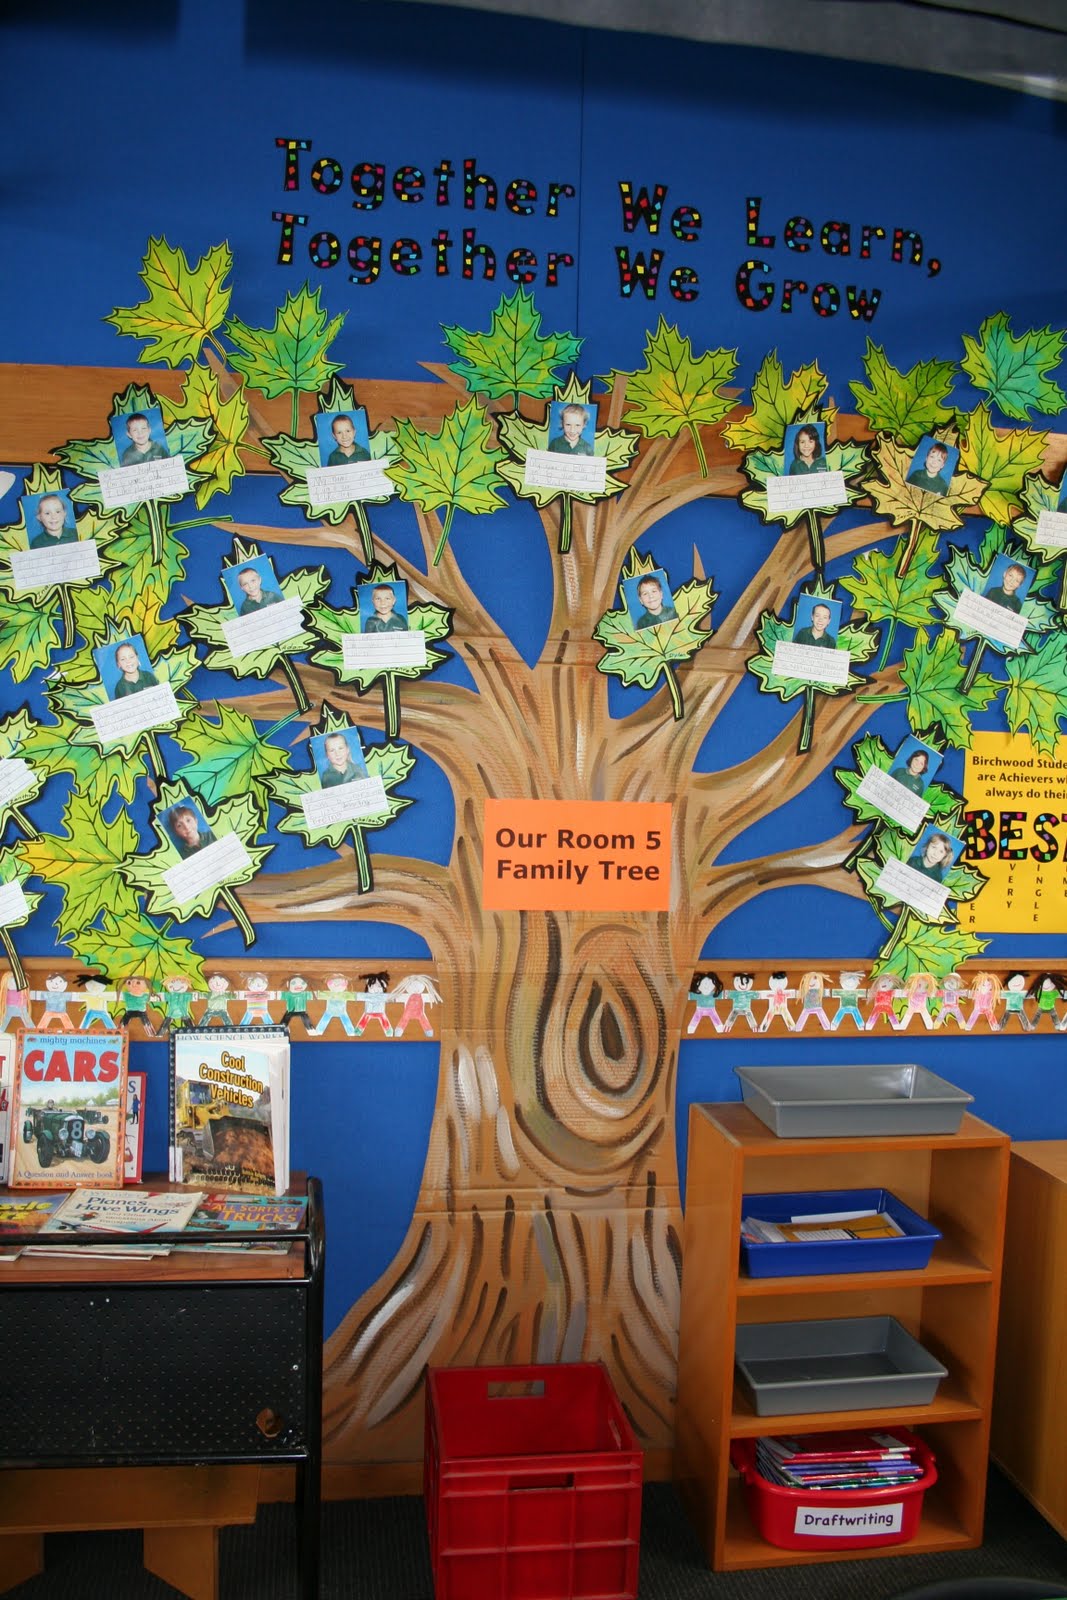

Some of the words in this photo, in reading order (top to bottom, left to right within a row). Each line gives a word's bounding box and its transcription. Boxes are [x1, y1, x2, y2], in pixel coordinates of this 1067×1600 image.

[275, 138, 576, 217] Together
[618, 181, 702, 242] We
[746, 197, 943, 279] Learn,
[272, 212, 575, 287] Together
[615, 246, 699, 302] We
[735, 260, 882, 323] Grow
[972, 756, 1034, 767] Birchwood
[977, 773, 996, 781] are
[999, 772, 1054, 783] Achievers
[985, 787, 1023, 800] always
[1026, 789, 1041, 798] do
[495, 828, 547, 848] Our
[558, 829, 635, 849] Room
[646, 831, 661, 850] 5
[497, 859, 589, 885] Family
[598, 860, 660, 881] Tree
[39, 1036, 69, 1046] mighty
[70, 1036, 107, 1044] machines
[24, 1049, 120, 1083] CARS
[221, 1051, 246, 1072] Cool
[198, 1062, 265, 1095] Construction
[209, 1083, 255, 1108] Vehicles
[71, 1121, 82, 1140] 8
[24, 1170, 54, 1179] Question
[56, 1170, 69, 1178] and
[75, 1203, 121, 1211] Have
[125, 1205, 180, 1215] Wings
[87, 1197, 148, 1206] Planes
[222, 1210, 297, 1222] TRUCKS
[804, 1513, 893, 1526] Draftwriting
